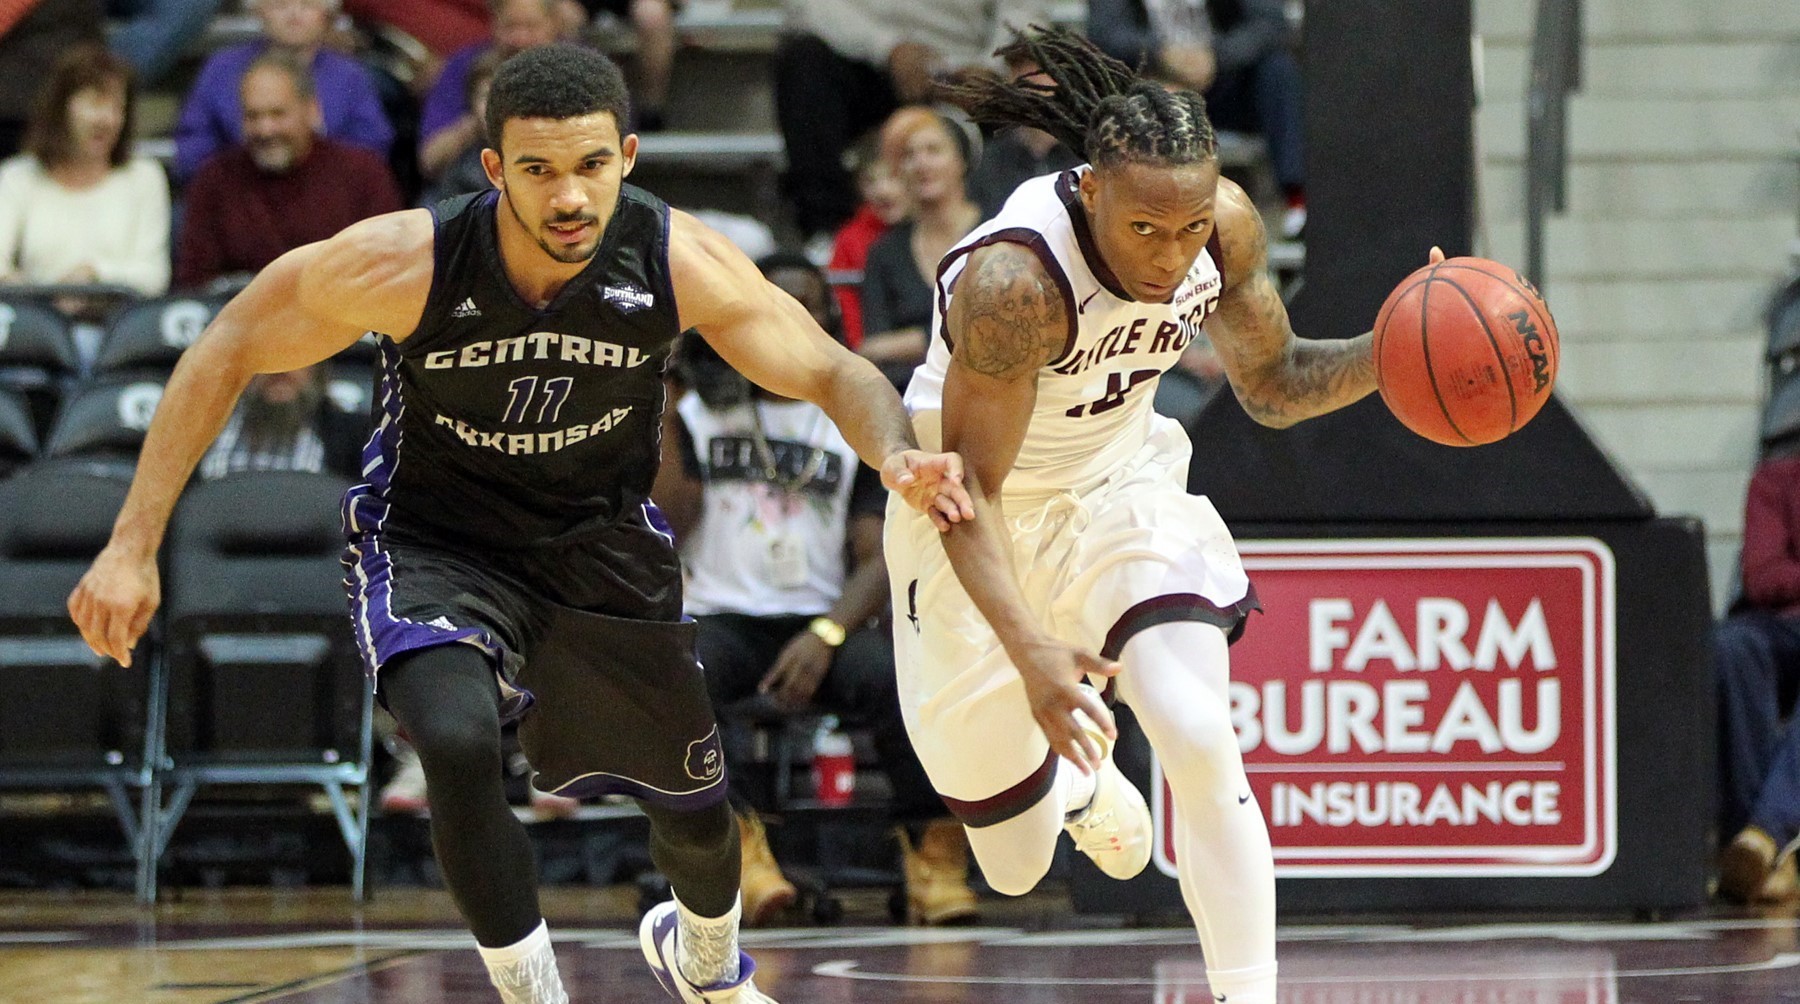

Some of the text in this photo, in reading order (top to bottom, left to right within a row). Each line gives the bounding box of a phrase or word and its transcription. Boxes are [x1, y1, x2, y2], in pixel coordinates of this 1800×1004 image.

[603, 286, 654, 307] SOUTHLAND
[1175, 276, 1218, 307] SUN BELT
[424, 331, 650, 369] CENTRAL
[1507, 309, 1549, 394] NCAA
[501, 375, 574, 423] 11
[435, 405, 633, 456] ARKANSAS
[1308, 597, 1557, 673] FARM
[1229, 678, 1562, 754] BUREAU
[1271, 779, 1562, 827] INSURANCE
